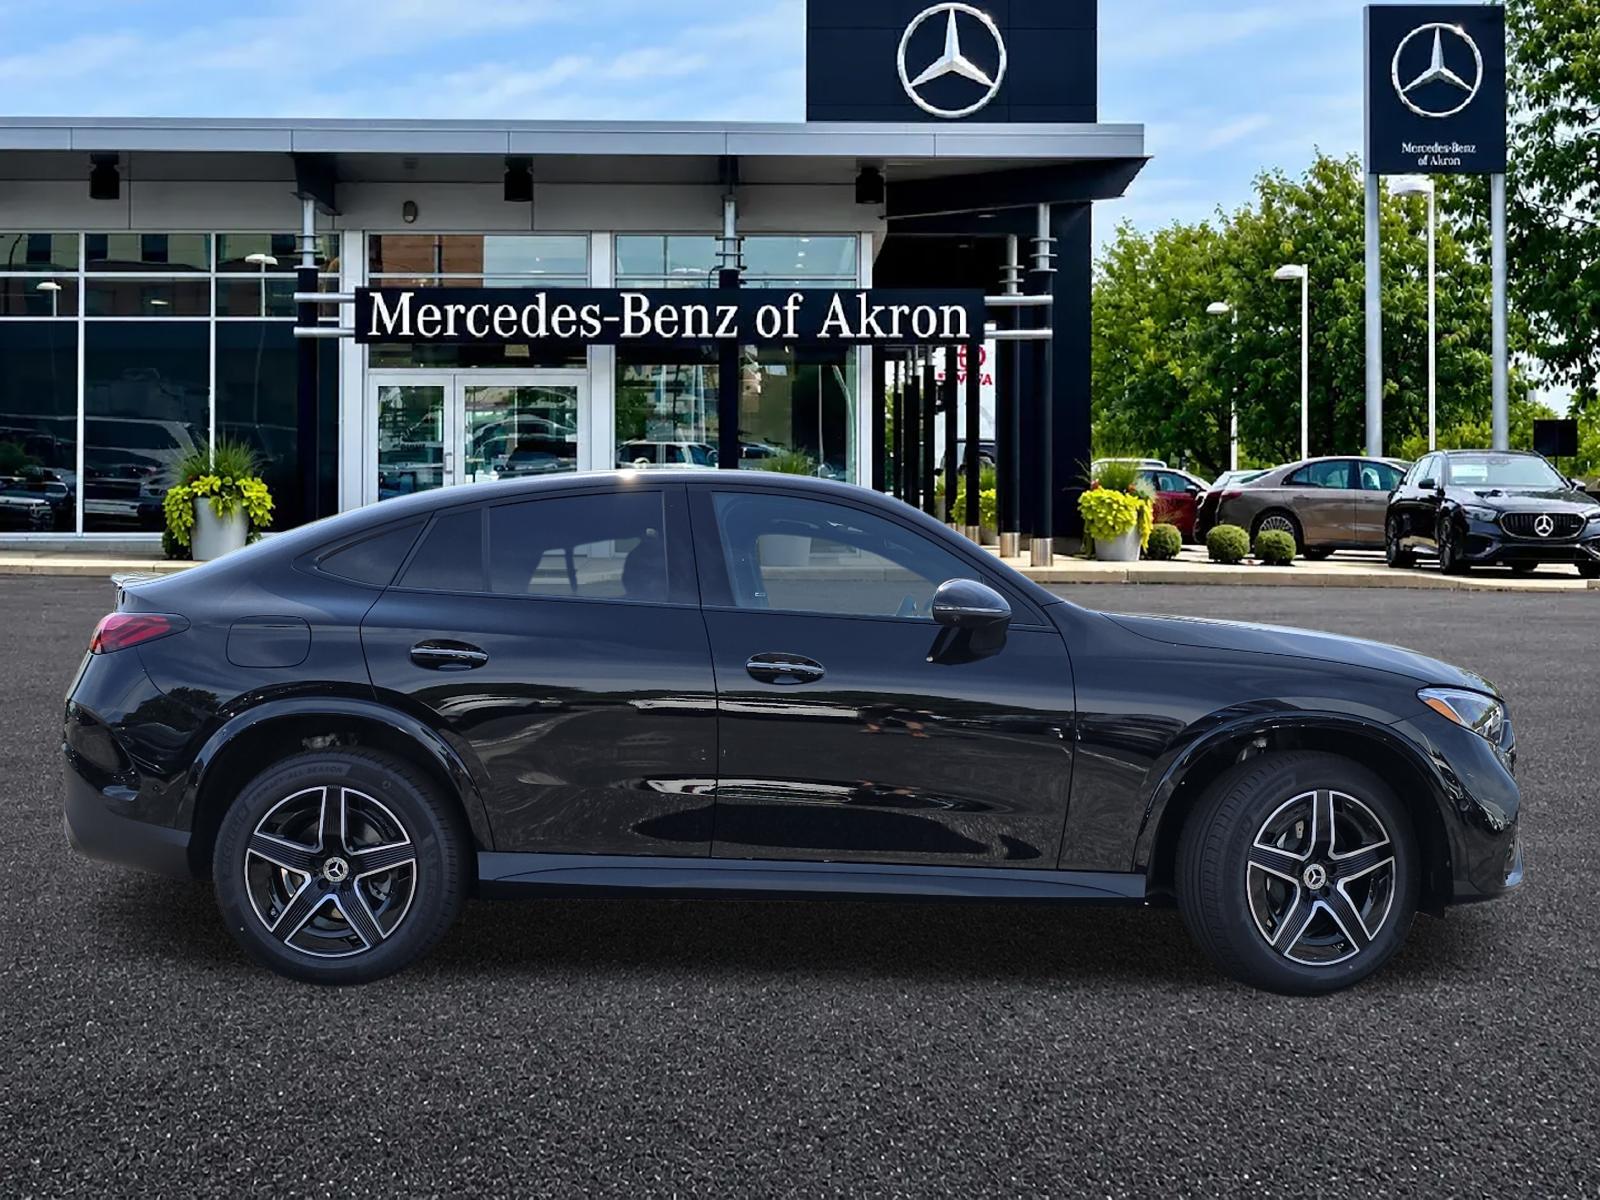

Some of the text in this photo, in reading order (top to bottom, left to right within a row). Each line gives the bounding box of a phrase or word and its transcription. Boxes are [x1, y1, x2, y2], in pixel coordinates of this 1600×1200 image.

[1401, 142, 1476, 154] Mercedes-Benz
[1417, 154, 1460, 166] of Akron
[367, 291, 971, 337] Mercedes-Benz of Akron
